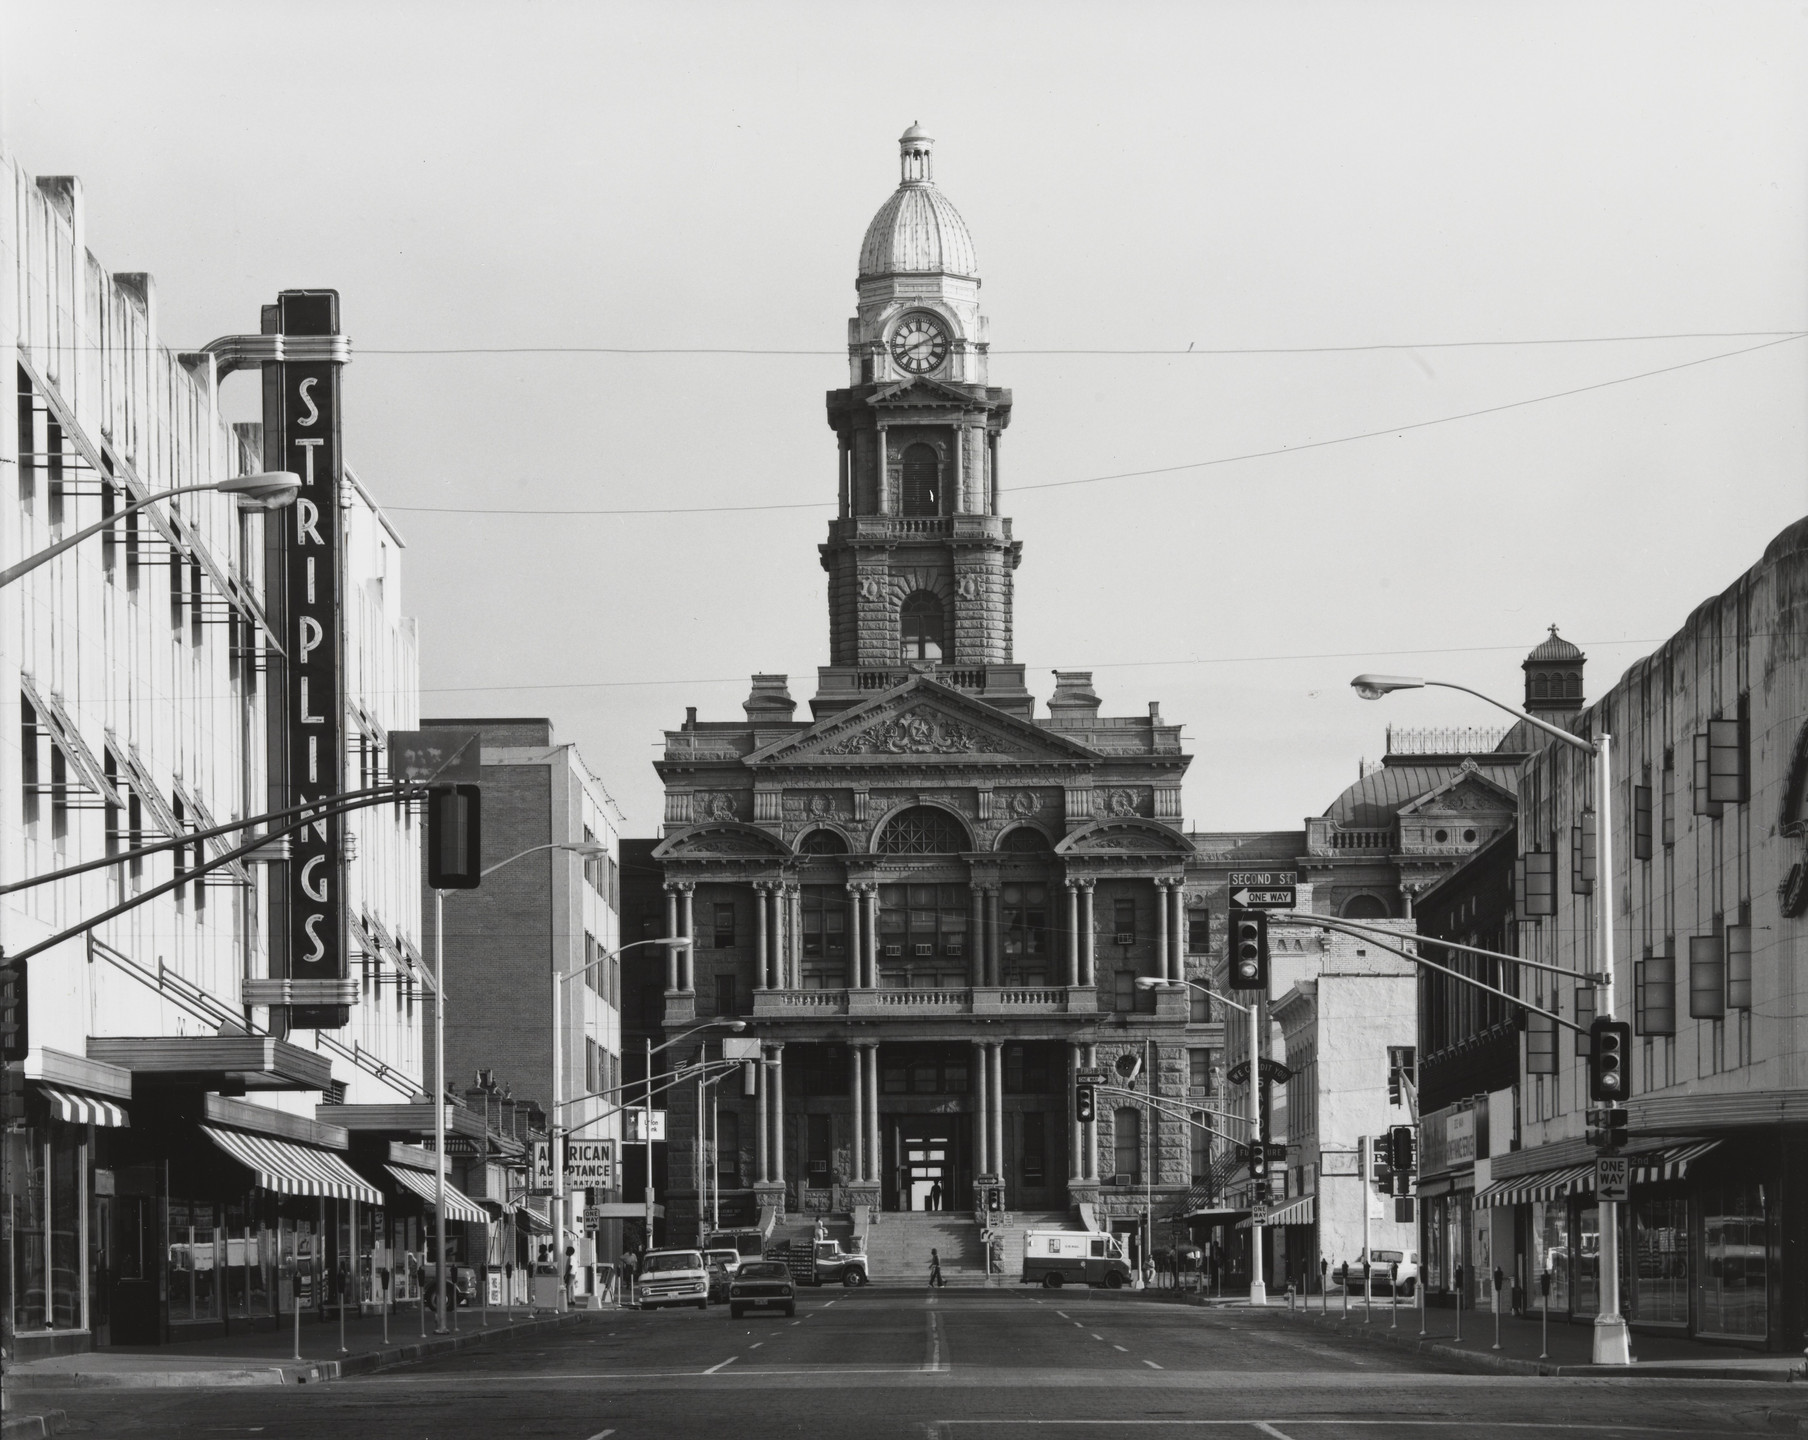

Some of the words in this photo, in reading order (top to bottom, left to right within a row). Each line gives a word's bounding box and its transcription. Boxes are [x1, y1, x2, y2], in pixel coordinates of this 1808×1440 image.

[295, 377, 327, 962] STRIPLINGS
[1232, 873, 1271, 885] SECOND
[1248, 892, 1267, 902] ONE
[1270, 893, 1289, 902] WAY
[1232, 1070, 1244, 1080] WE
[1245, 1063, 1272, 1074] CDIT
[1274, 1066, 1288, 1080] YOU
[538, 1145, 610, 1161] ARICAN
[1239, 1148, 1282, 1157] FUURE
[539, 1165, 610, 1177] ACPTANCE
[1600, 1160, 1625, 1172] ONE
[1600, 1173, 1625, 1185] WAY
